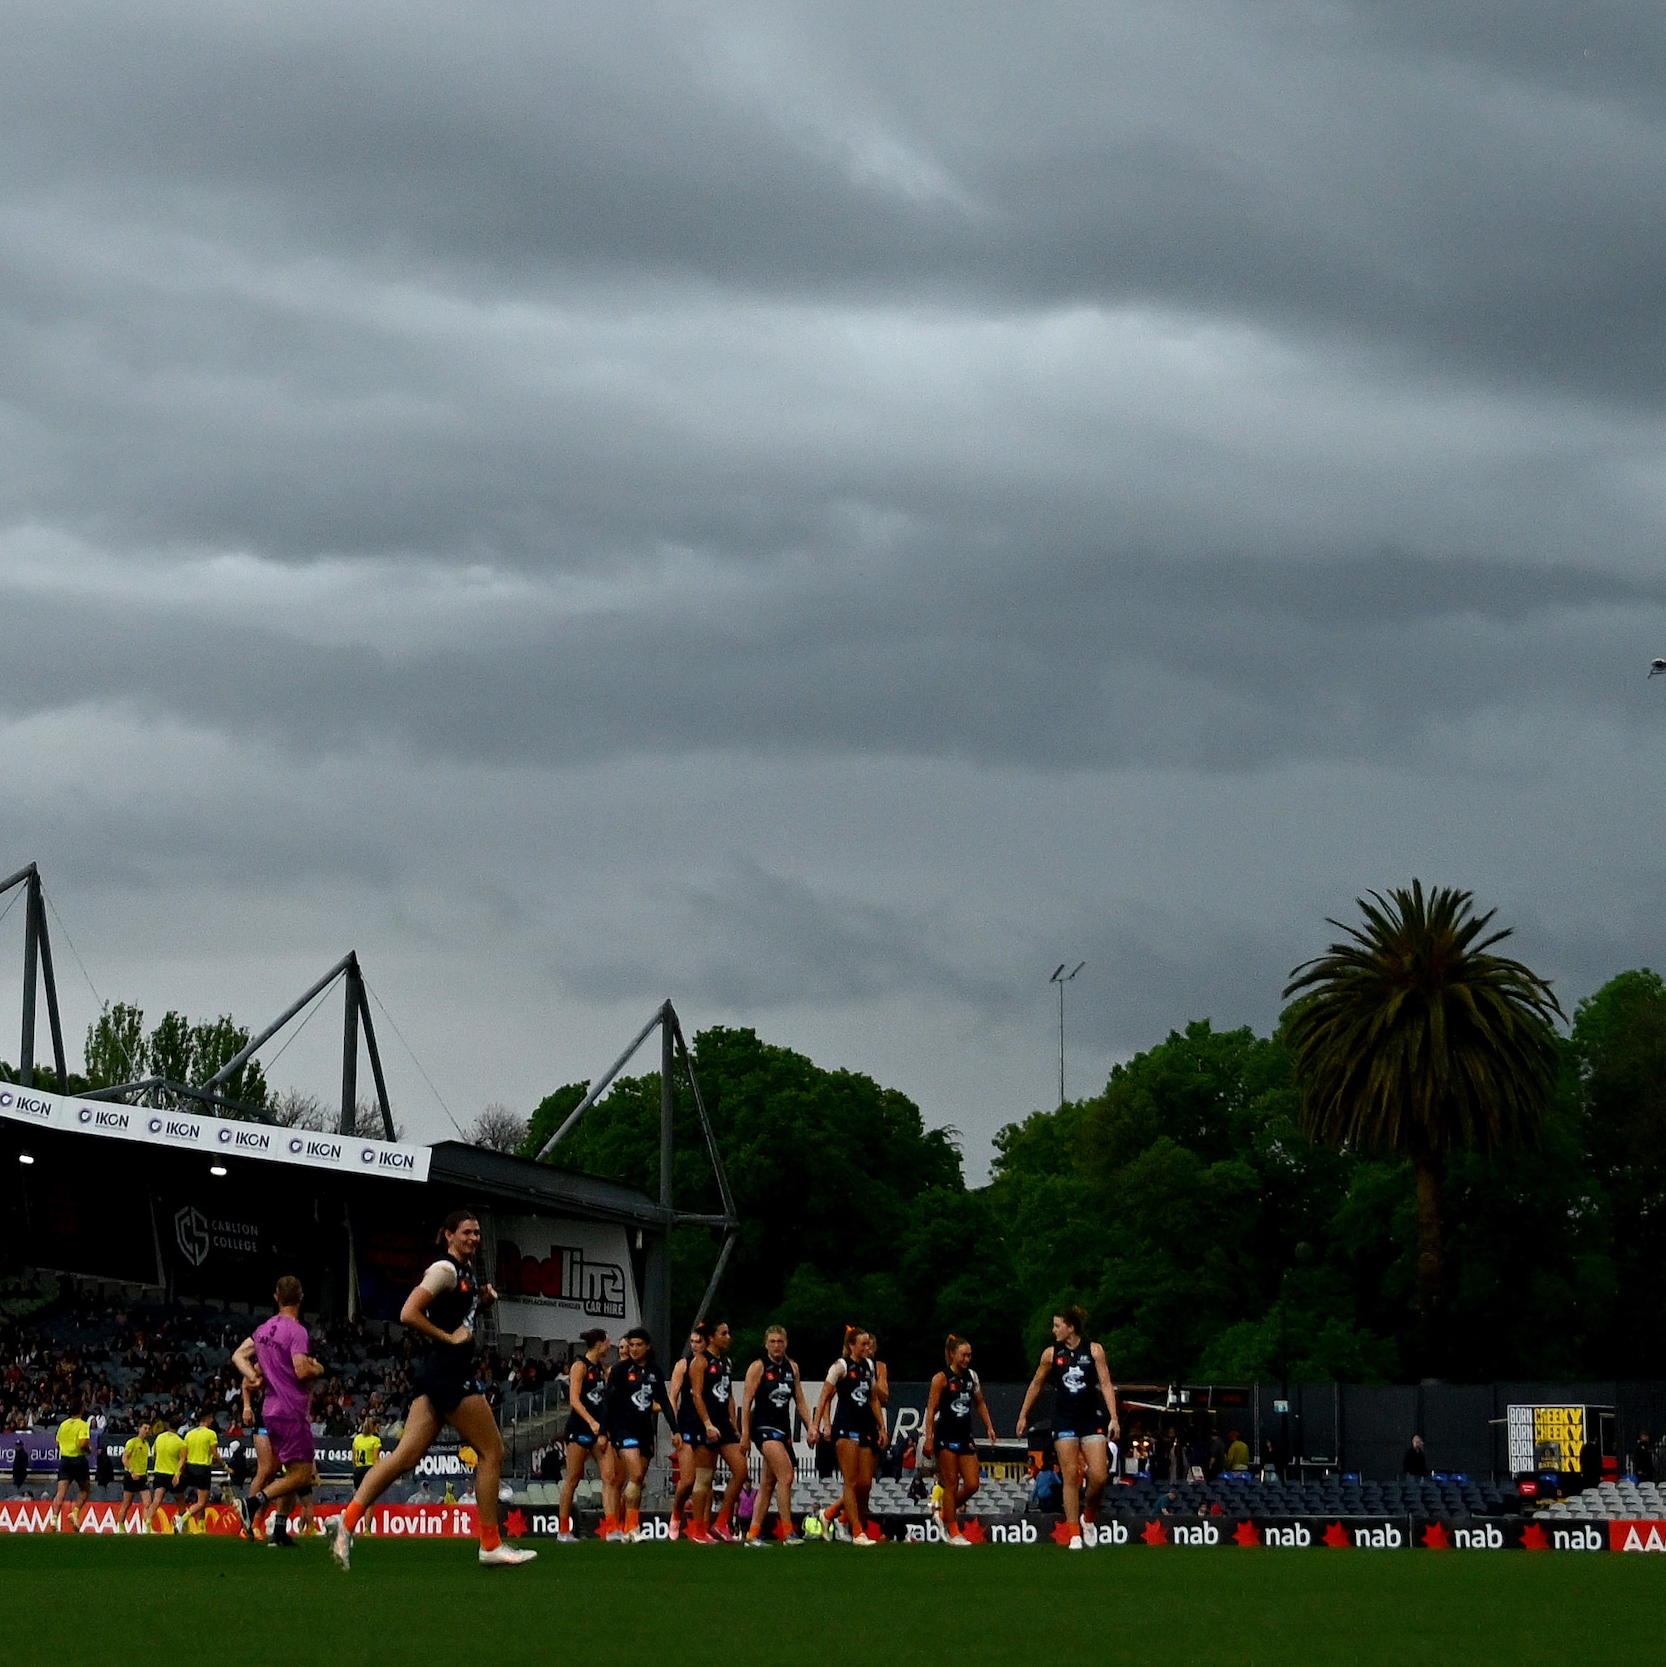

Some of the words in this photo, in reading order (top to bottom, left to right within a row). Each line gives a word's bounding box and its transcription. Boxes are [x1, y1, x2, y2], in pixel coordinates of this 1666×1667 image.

[17, 1097, 51, 1115] IKON
[96, 1112, 129, 1127] IKON
[167, 1122, 199, 1137] IKON
[236, 1132, 269, 1147] IKON
[307, 1142, 341, 1158] IKON
[380, 1152, 414, 1168] IKON
[212, 1219, 259, 1237] CARLTON
[213, 1235, 258, 1253] COLLEGE
[585, 1300, 602, 1313] CAR
[604, 1302, 624, 1314] HIRE
[1510, 1408, 1532, 1423] BORN
[1534, 1408, 1582, 1424] CHEEKY
[1511, 1424, 1533, 1440] BORN
[1535, 1424, 1582, 1440] CHEEKY
[1511, 1441, 1533, 1456] BORN
[1511, 1457, 1533, 1472] BORN
[384, 1508, 449, 1533] lovin'
[454, 1508, 471, 1534] it
[640, 1517, 670, 1540] ab
[908, 1520, 940, 1542] ab
[992, 1521, 1037, 1543] nab
[1096, 1521, 1128, 1545] ab
[1173, 1522, 1218, 1545] nab
[1265, 1523, 1310, 1547] nab
[1355, 1524, 1401, 1547] nab
[1455, 1524, 1502, 1548] nab
[1554, 1526, 1602, 1550] nab
